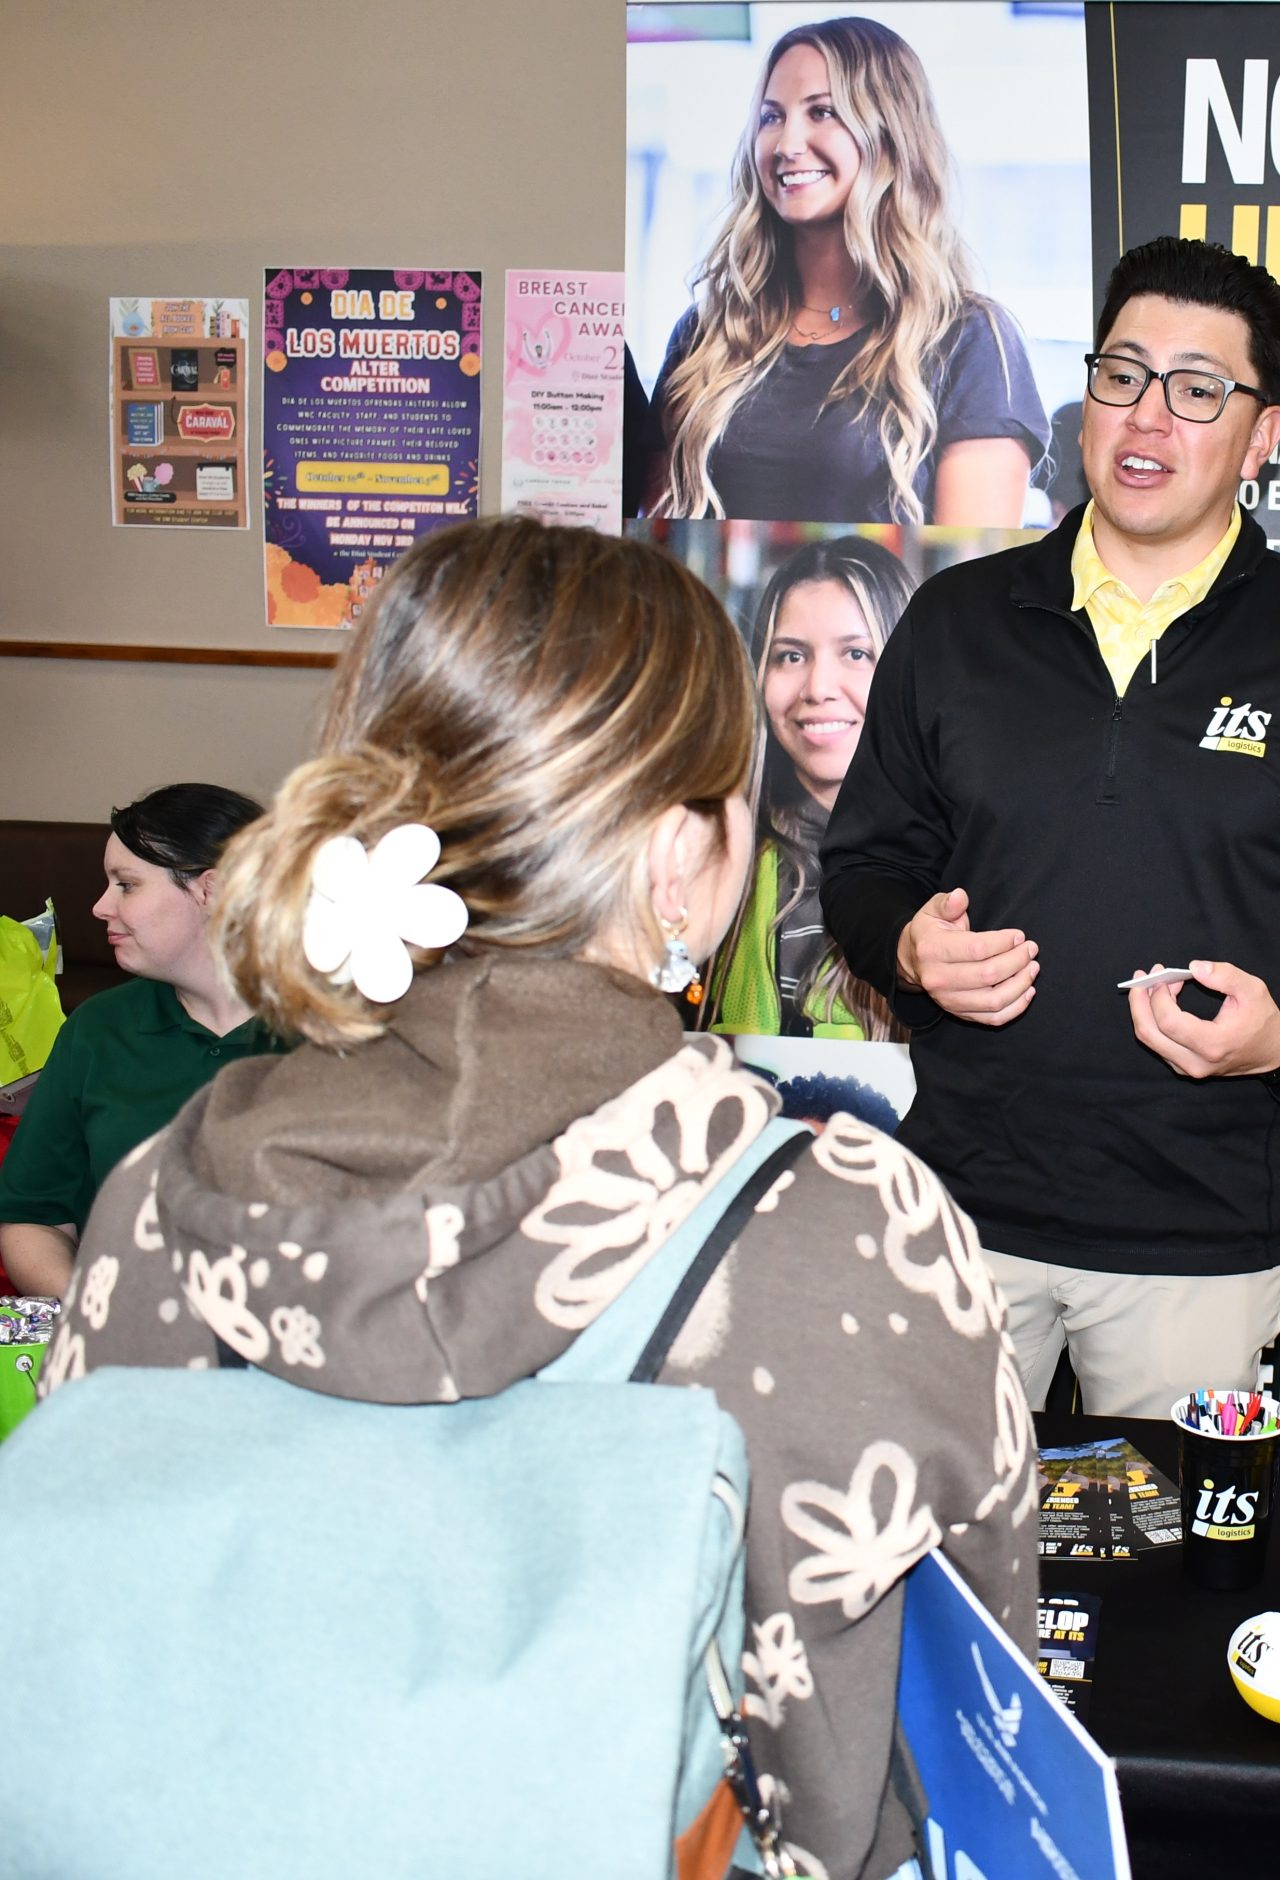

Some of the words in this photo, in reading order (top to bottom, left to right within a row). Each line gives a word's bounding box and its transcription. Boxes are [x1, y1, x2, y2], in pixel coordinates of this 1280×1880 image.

[519, 281, 588, 296] BREAST
[332, 290, 375, 319] DIA
[379, 291, 415, 320] DE
[287, 328, 335, 358] LOS
[340, 330, 460, 360] MUERTOS
[603, 345, 624, 370] 2
[351, 360, 400, 377] ALTER
[320, 377, 430, 393] COMPETITION
[282, 397, 295, 405] DIA
[298, 397, 307, 405] DE
[310, 398, 324, 406] LOS
[327, 398, 361, 407] MUERTOS
[441, 400, 467, 408] ALLOW
[547, 391, 574, 399] Button
[576, 392, 604, 401] Making
[185, 415, 229, 429] CARAVAL
[383, 412, 398, 420] AND
[401, 413, 438, 421] STUDENTS
[442, 413, 452, 421] TO
[276, 423, 335, 432] COMMEMORATE
[354, 425, 386, 434] MEMORY
[403, 426, 423, 434] THEIR
[427, 427, 444, 435] LATE
[447, 427, 472, 436] LOVED
[289, 437, 308, 445] ONES
[333, 438, 363, 446] PICTURE
[402, 439, 422, 448] THEIR
[425, 440, 459, 449] BELOVED
[323, 451, 337, 459] AND
[340, 451, 374, 460] FAVORITE
[378, 452, 402, 460] FOODS
[424, 454, 451, 462] DRINKS
[277, 498, 297, 510] THE
[299, 499, 342, 511] WINNERS
[347, 500, 361, 511] OF
[362, 500, 382, 512] THE
[326, 517, 340, 528] BE
[342, 517, 399, 530] ANNOUNCED
[401, 518, 415, 530] ON
[330, 533, 371, 545] MONDAY
[373, 534, 393, 546] NOV
[1206, 696, 1272, 741] its
[1227, 740, 1262, 753] logistics
[1196, 1479, 1259, 1525] its
[1217, 1529, 1251, 1538] logistics
[1053, 1630, 1066, 1640] AT
[1068, 1631, 1085, 1641] ITS
[1237, 1625, 1270, 1664] its
